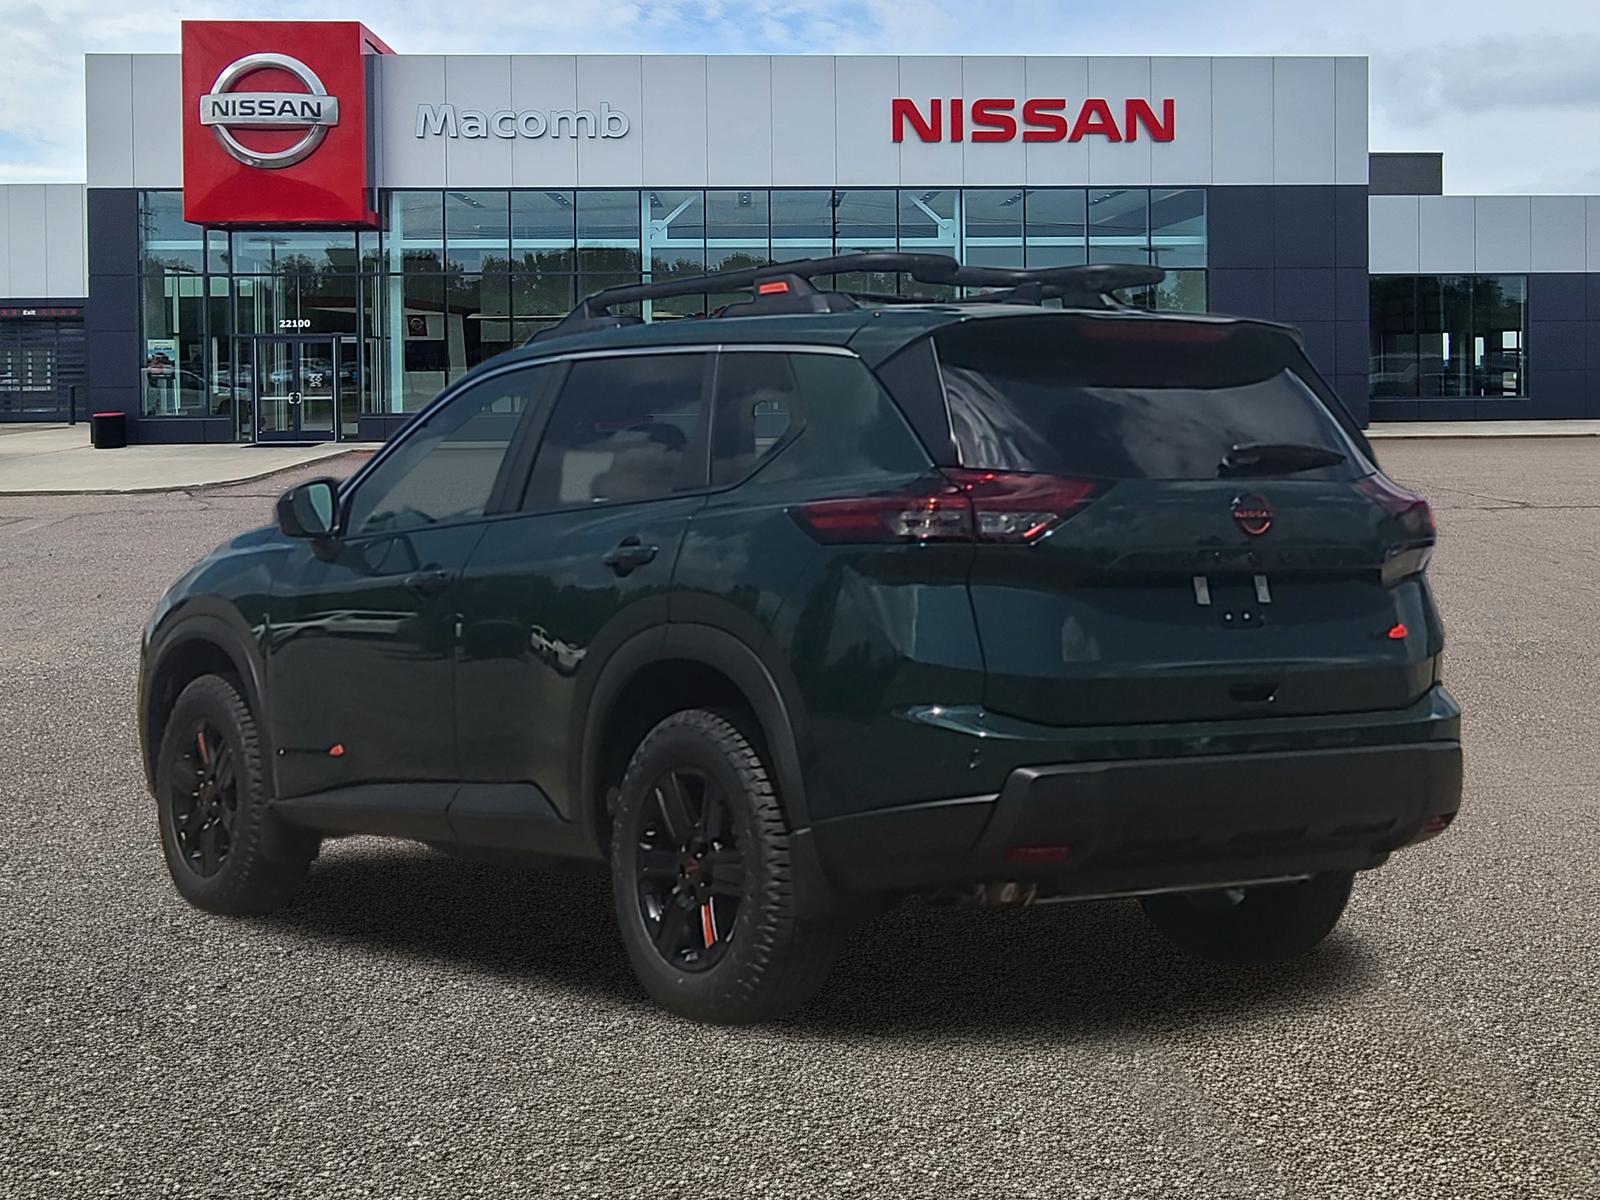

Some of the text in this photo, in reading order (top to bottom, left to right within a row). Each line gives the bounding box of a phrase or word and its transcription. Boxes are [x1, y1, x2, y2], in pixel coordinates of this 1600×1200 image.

[211, 100, 322, 117] NISSAN
[415, 101, 630, 139] Macomb
[892, 98, 1175, 143] NISSAN
[279, 319, 311, 328] 22100
